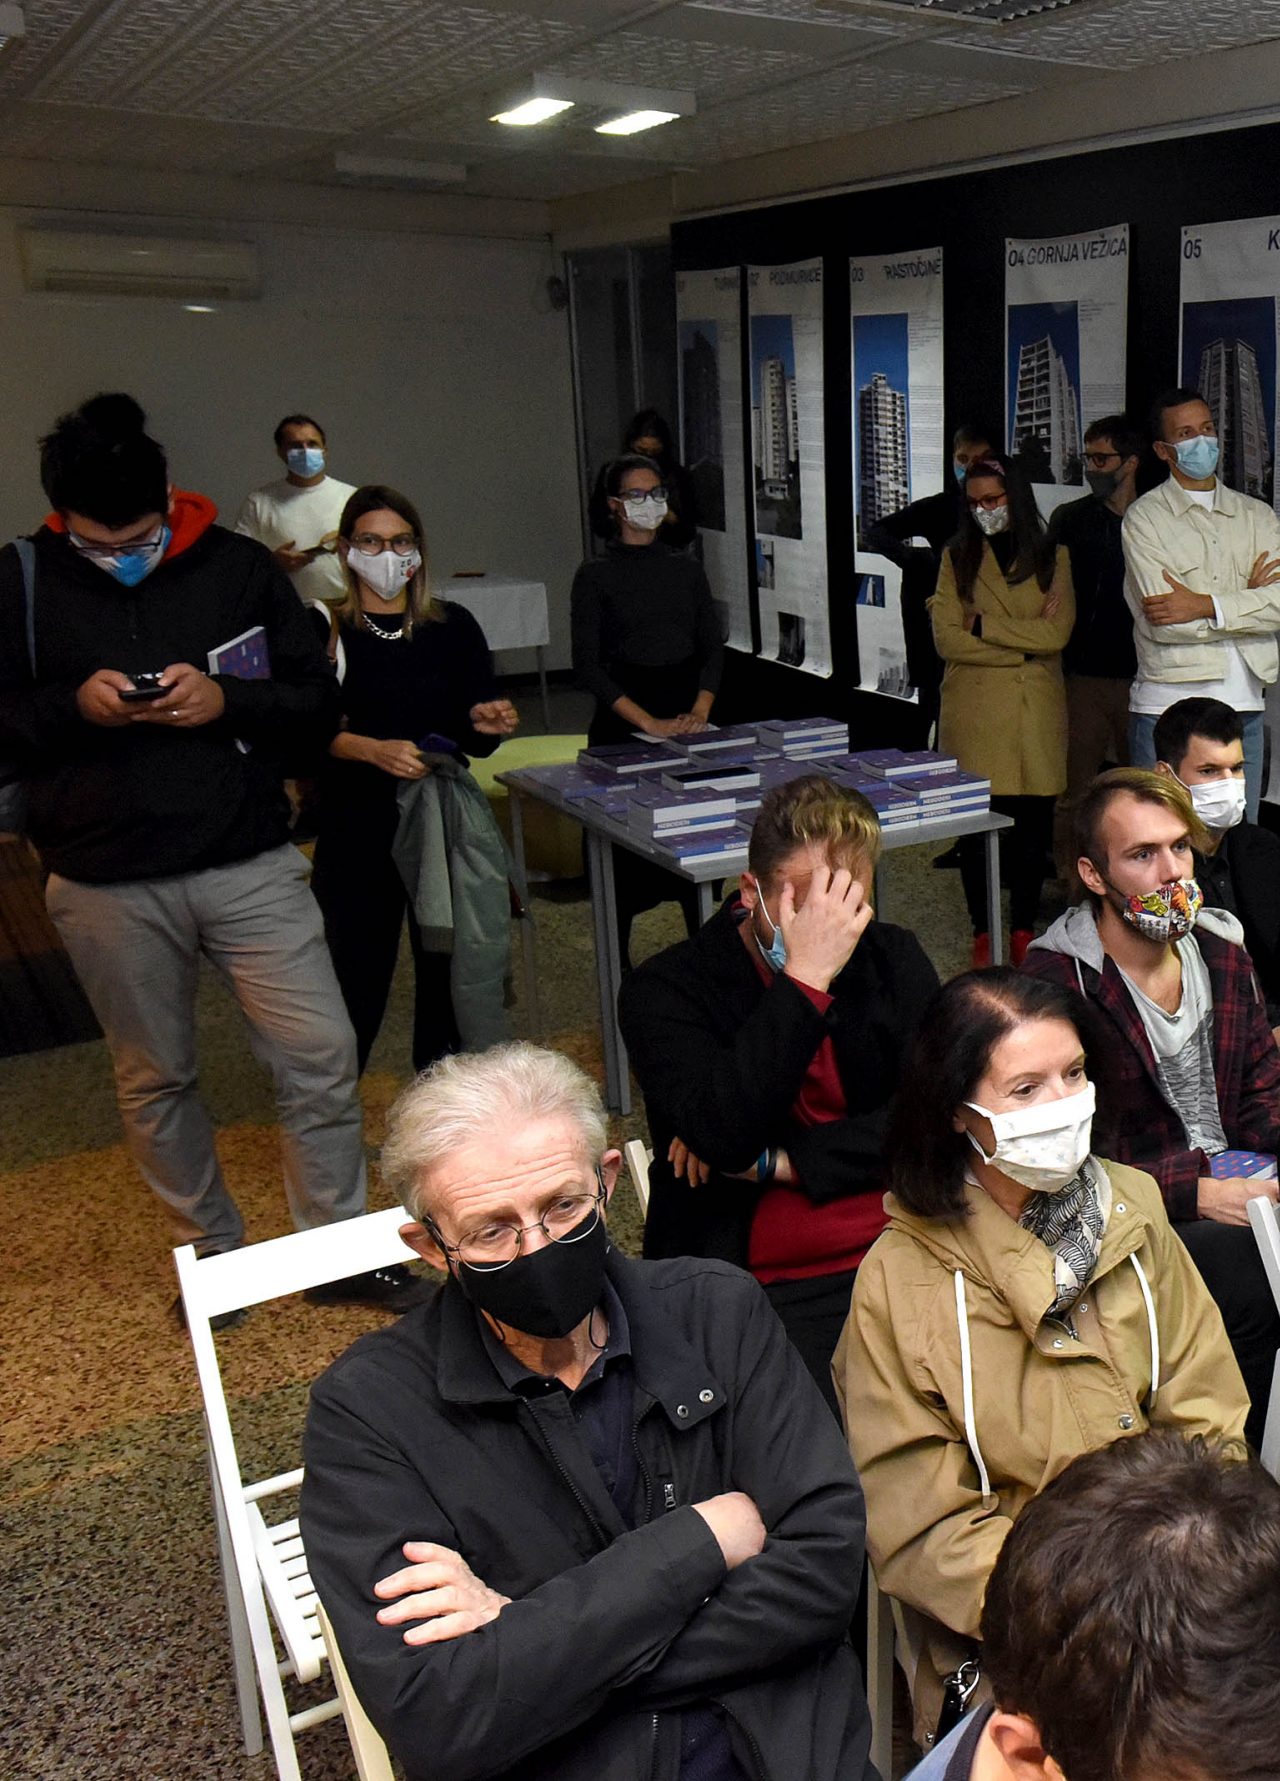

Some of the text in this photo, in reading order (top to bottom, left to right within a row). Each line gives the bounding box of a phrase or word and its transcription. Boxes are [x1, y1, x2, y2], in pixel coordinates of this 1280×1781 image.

[1008, 233, 1128, 267] 04 GORNJA VEŽICA
[1183, 238, 1202, 260] 05
[852, 266, 864, 282] 03
